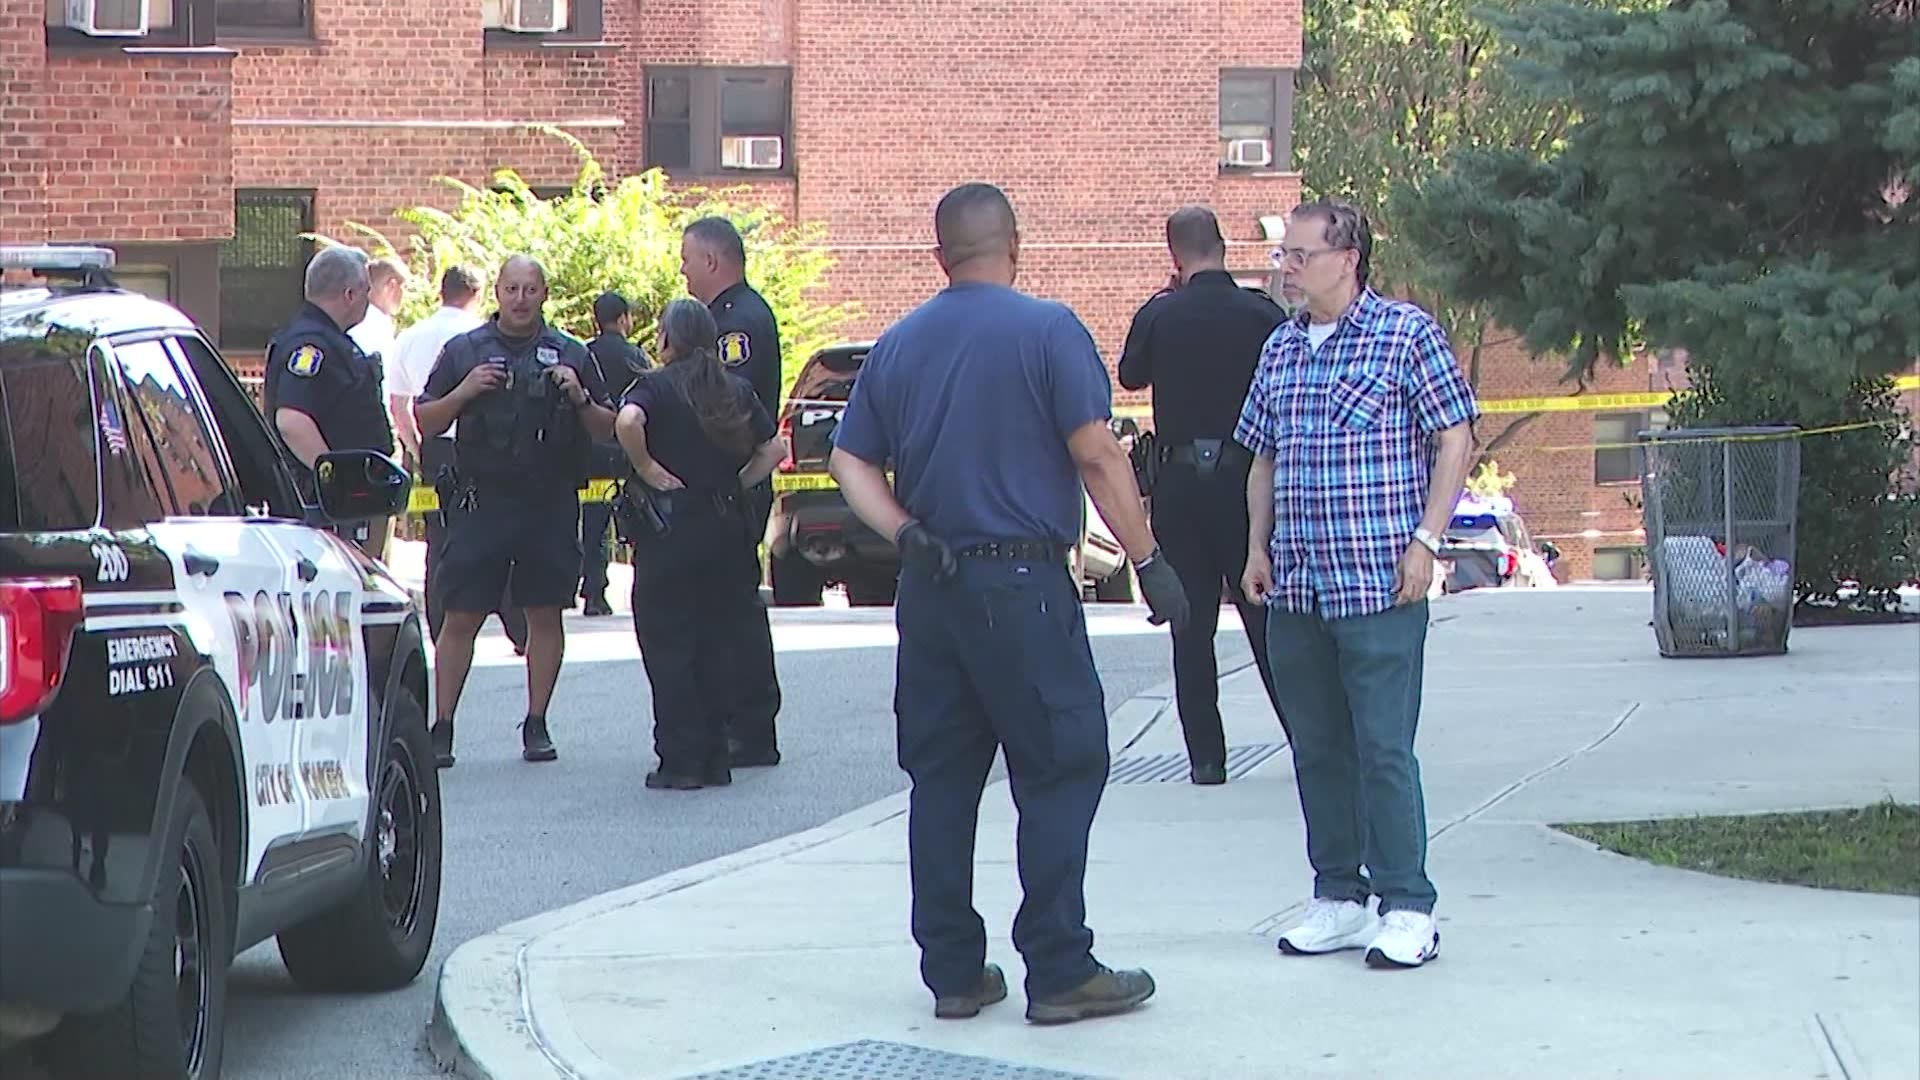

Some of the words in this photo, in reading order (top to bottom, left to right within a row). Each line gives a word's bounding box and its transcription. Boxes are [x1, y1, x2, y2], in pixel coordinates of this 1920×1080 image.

[91, 543, 129, 582] 200
[107, 635, 178, 664] EMERGENCY
[223, 589, 354, 724] POLICE
[109, 667, 146, 695] DIAL
[147, 663, 174, 690] 911
